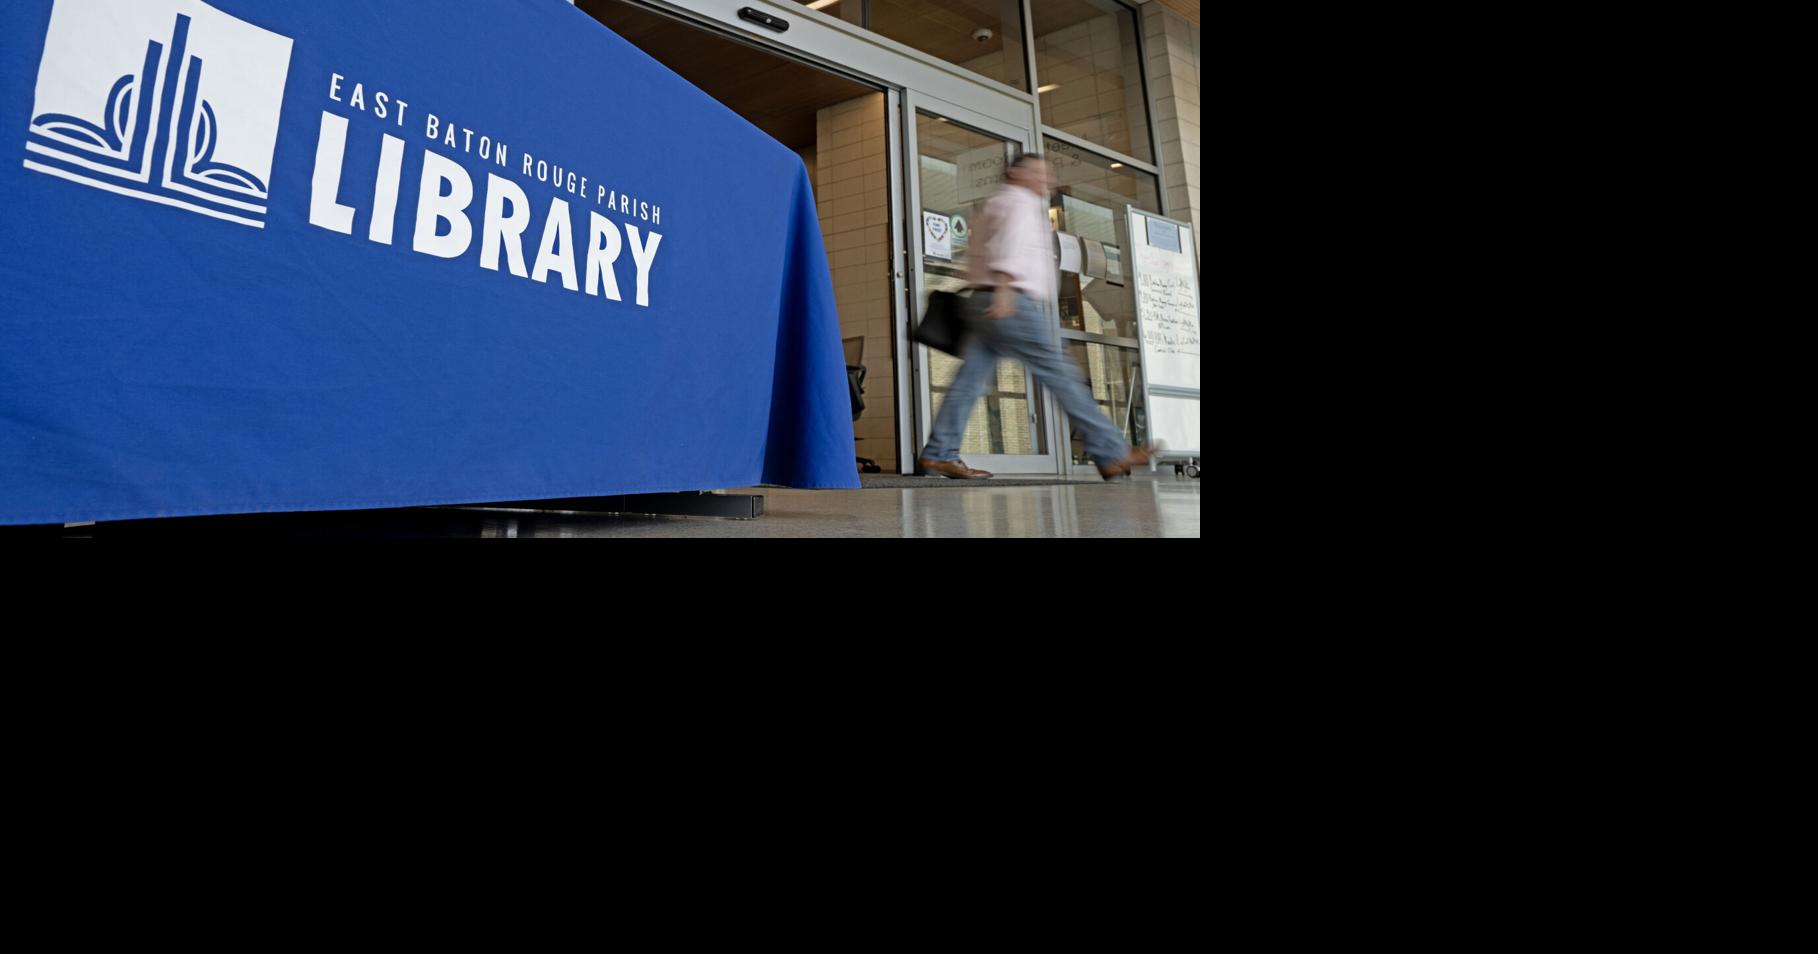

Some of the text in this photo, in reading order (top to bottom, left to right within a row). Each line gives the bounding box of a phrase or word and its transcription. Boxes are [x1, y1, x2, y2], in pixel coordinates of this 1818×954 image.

[308, 110, 663, 307] LIBRARY
[329, 72, 661, 225] EAST BATON ROUGE PARISH
